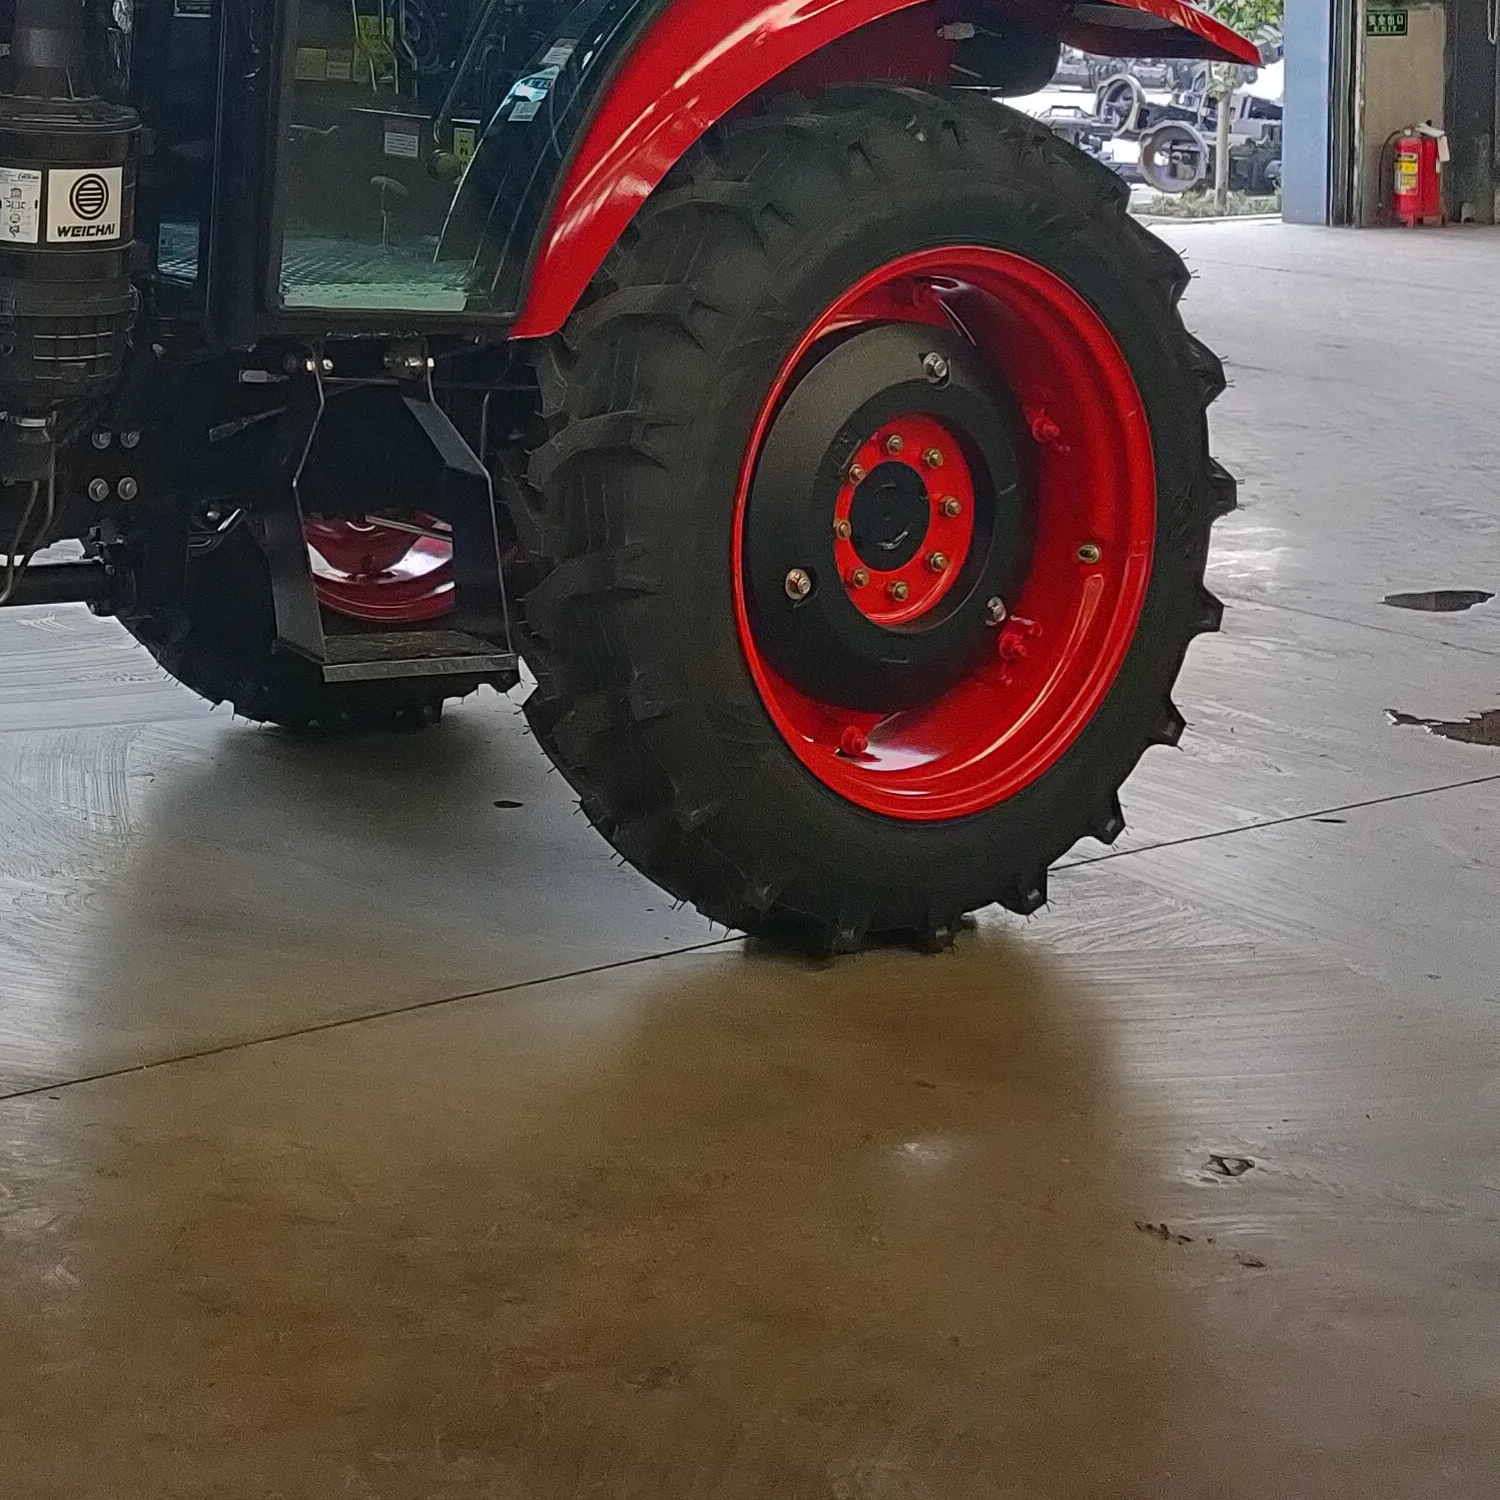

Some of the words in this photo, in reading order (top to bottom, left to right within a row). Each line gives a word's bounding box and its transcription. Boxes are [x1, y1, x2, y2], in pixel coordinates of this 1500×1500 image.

[1367, 13, 1404, 26] 安全出口
[57, 223, 115, 237] WEICHAI
